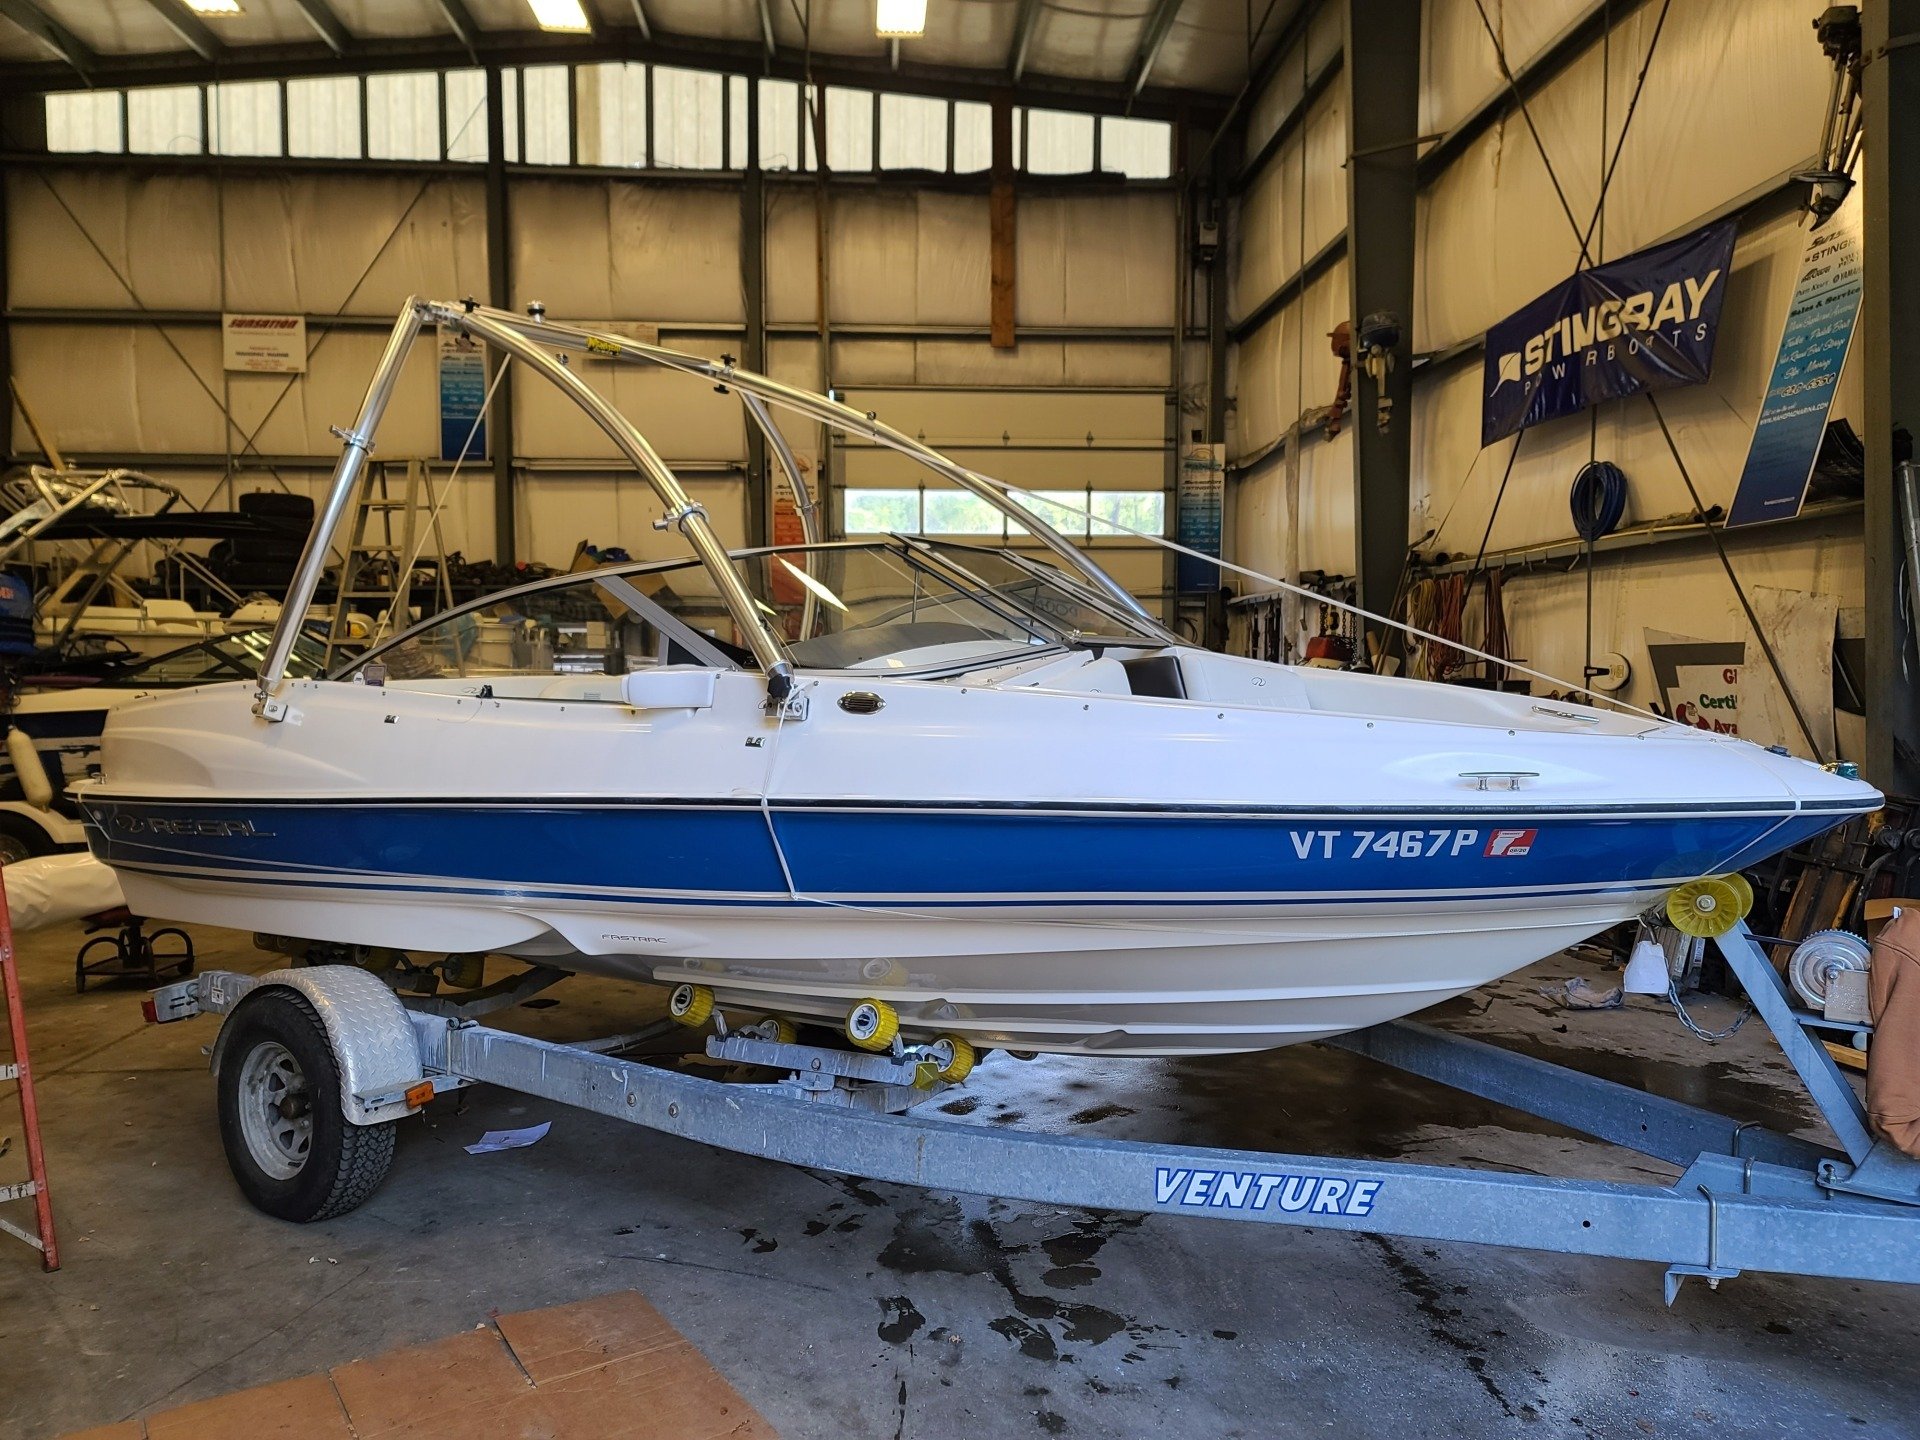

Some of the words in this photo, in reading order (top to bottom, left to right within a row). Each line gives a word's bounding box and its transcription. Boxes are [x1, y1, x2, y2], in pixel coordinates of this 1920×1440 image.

[1524, 269, 1721, 376] STINGRAY
[148, 816, 277, 837] REGAL
[1289, 830, 1341, 859] VT
[1351, 829, 1479, 859] 7467P
[601, 934, 668, 944] FASTRAC
[1156, 1167, 1385, 1217] VENTURE
